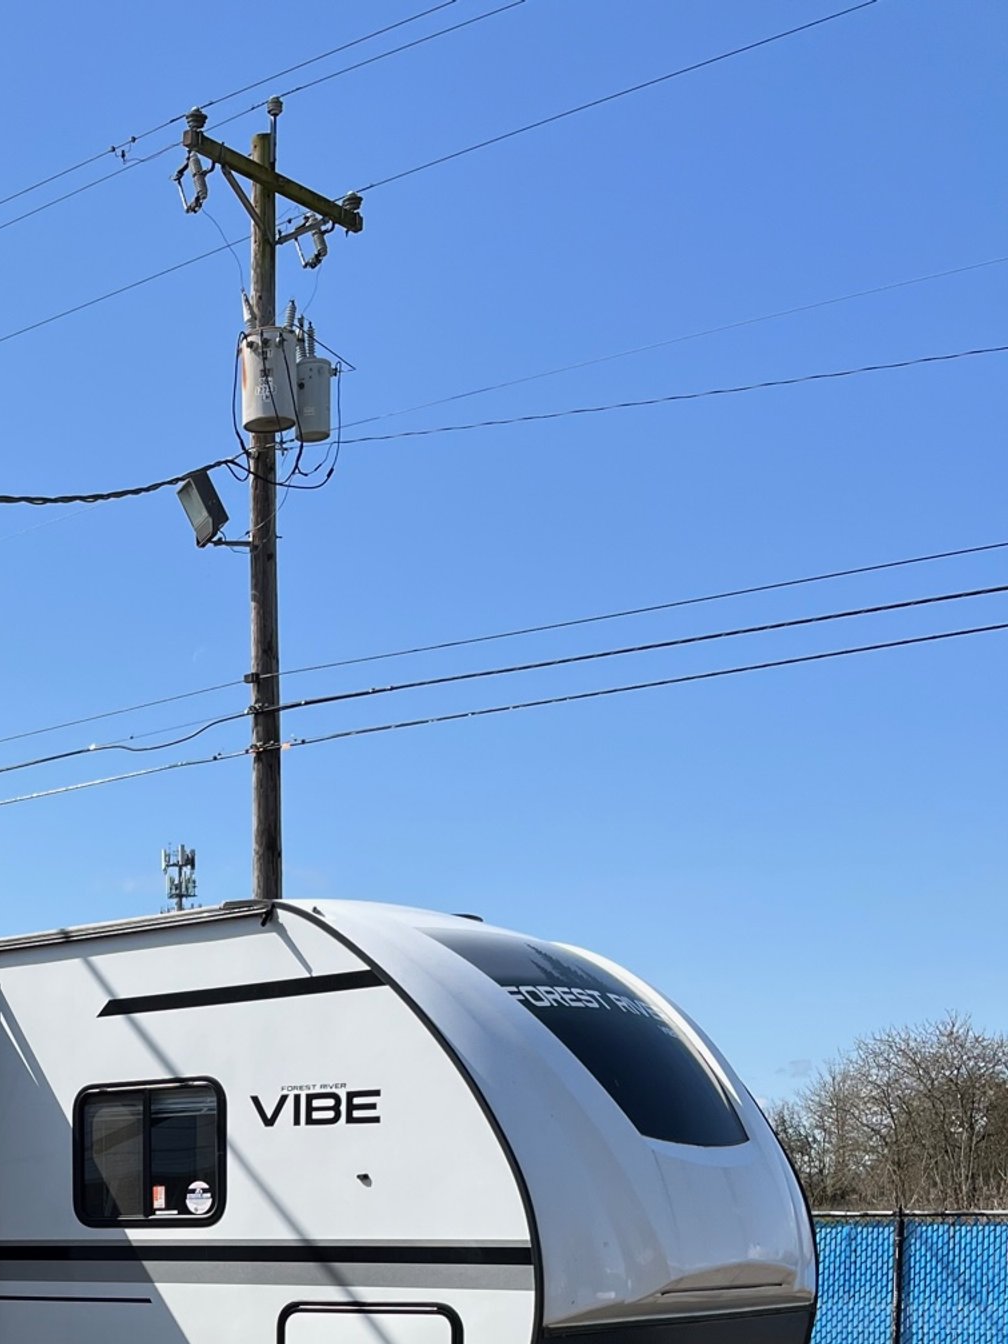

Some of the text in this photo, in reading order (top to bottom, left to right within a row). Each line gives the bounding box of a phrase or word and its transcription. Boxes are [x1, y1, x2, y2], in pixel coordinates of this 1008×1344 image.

[500, 986, 611, 1010] FOREST
[280, 1084, 316, 1092] FOREST
[249, 1089, 381, 1127] VIBE
